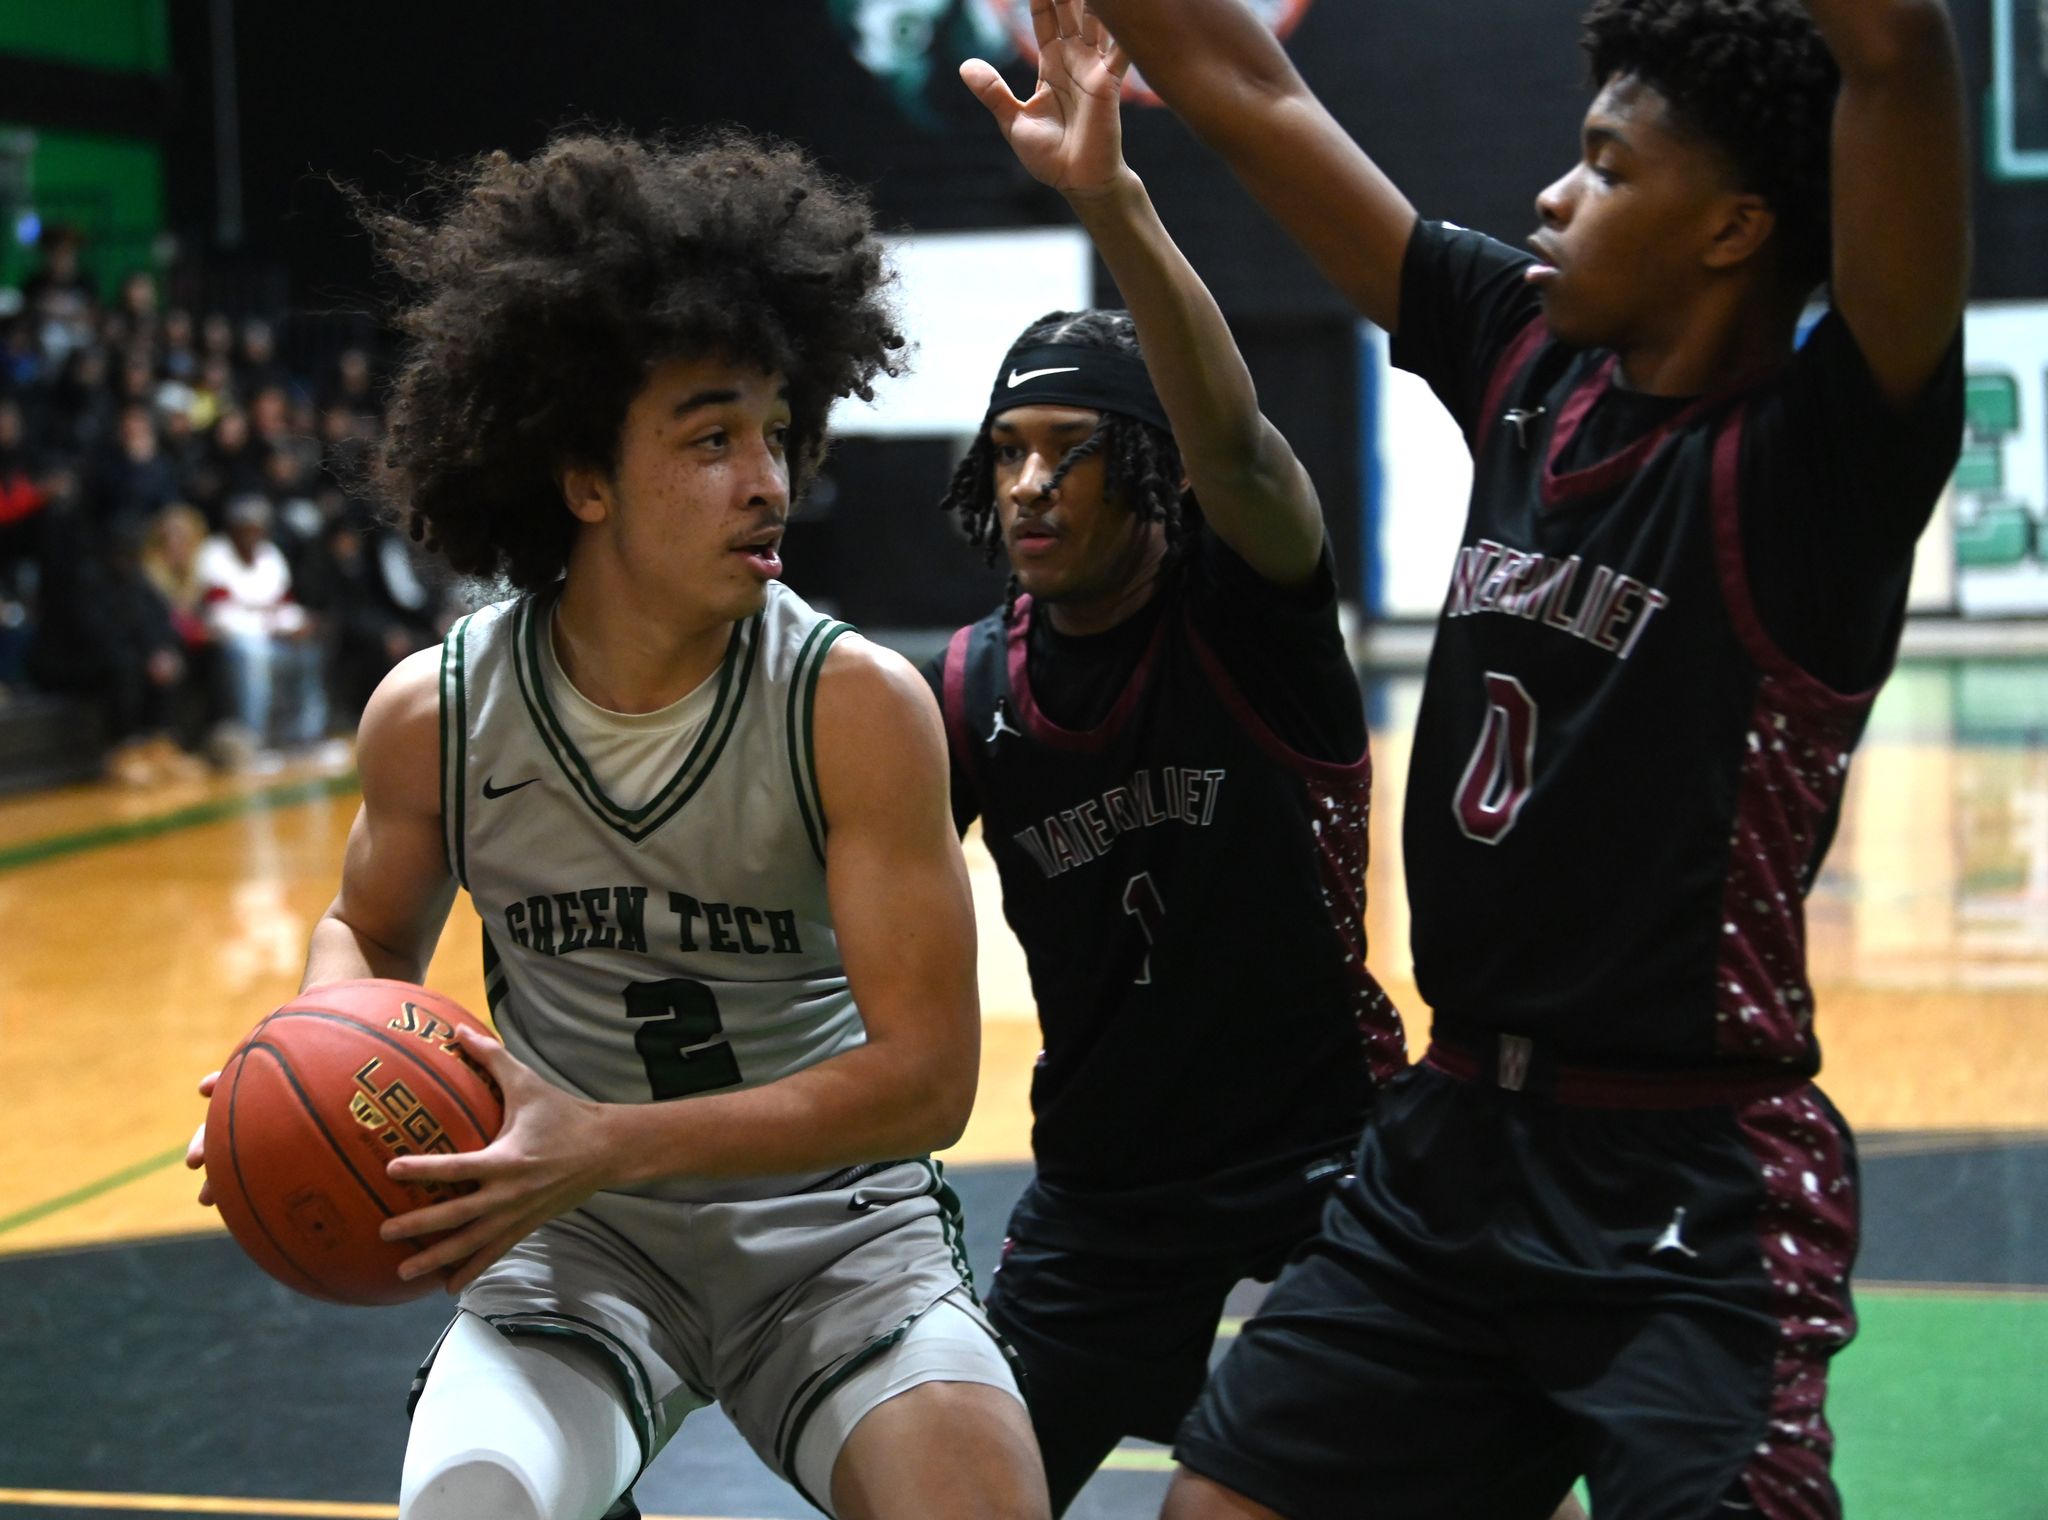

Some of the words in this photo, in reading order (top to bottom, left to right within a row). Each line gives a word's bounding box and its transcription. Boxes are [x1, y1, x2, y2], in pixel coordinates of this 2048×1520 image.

[1452, 670, 1538, 846] 0
[504, 886, 649, 956] GREEN
[667, 890, 803, 955] TECH
[1121, 870, 1166, 985] 1
[621, 977, 744, 1101] 2
